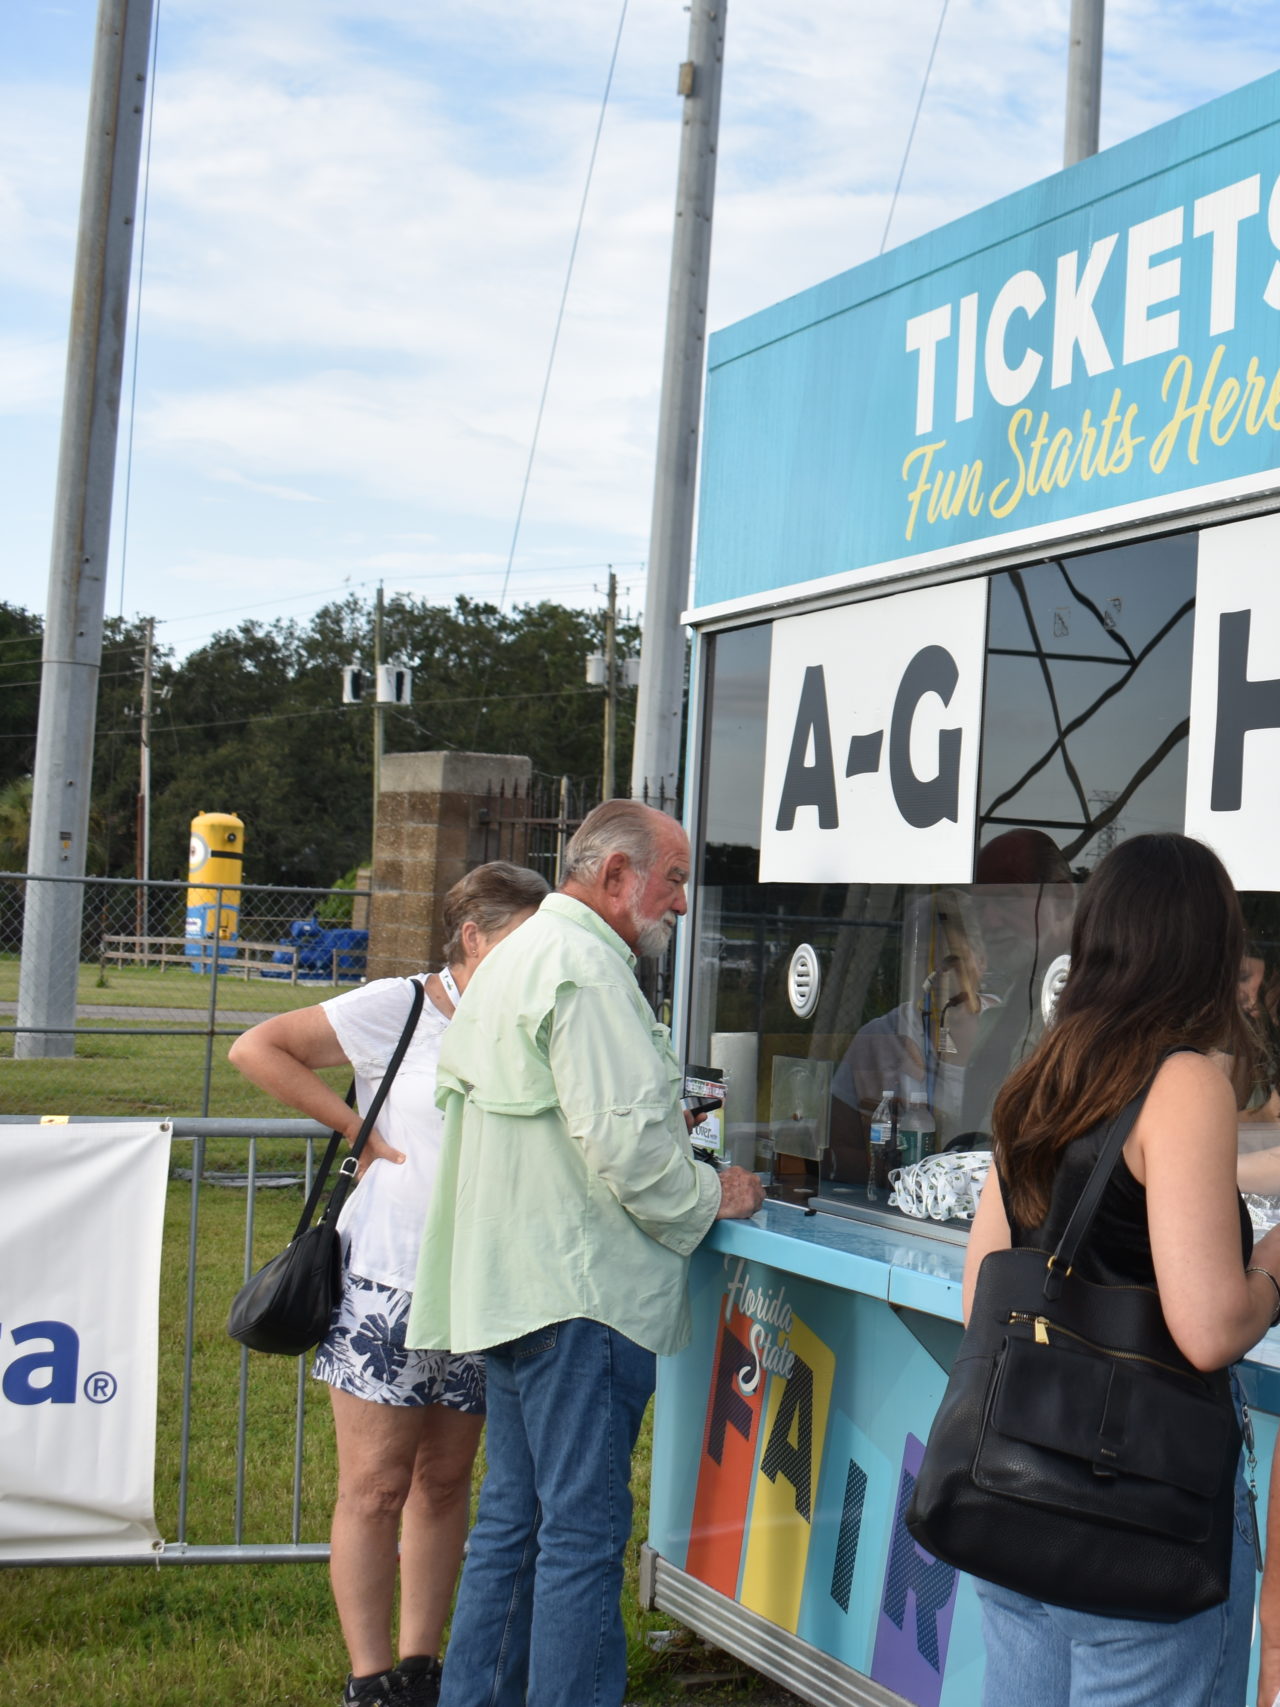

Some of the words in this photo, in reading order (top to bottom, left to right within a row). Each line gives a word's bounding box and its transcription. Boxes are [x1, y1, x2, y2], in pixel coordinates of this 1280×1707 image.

[901, 439, 984, 542] Fun
[989, 387, 1145, 519] Starts
[775, 644, 963, 831] A-G
[724, 1256, 792, 1325] Florida
[738, 1323, 795, 1393] State
[707, 1326, 957, 1675] FAIR
